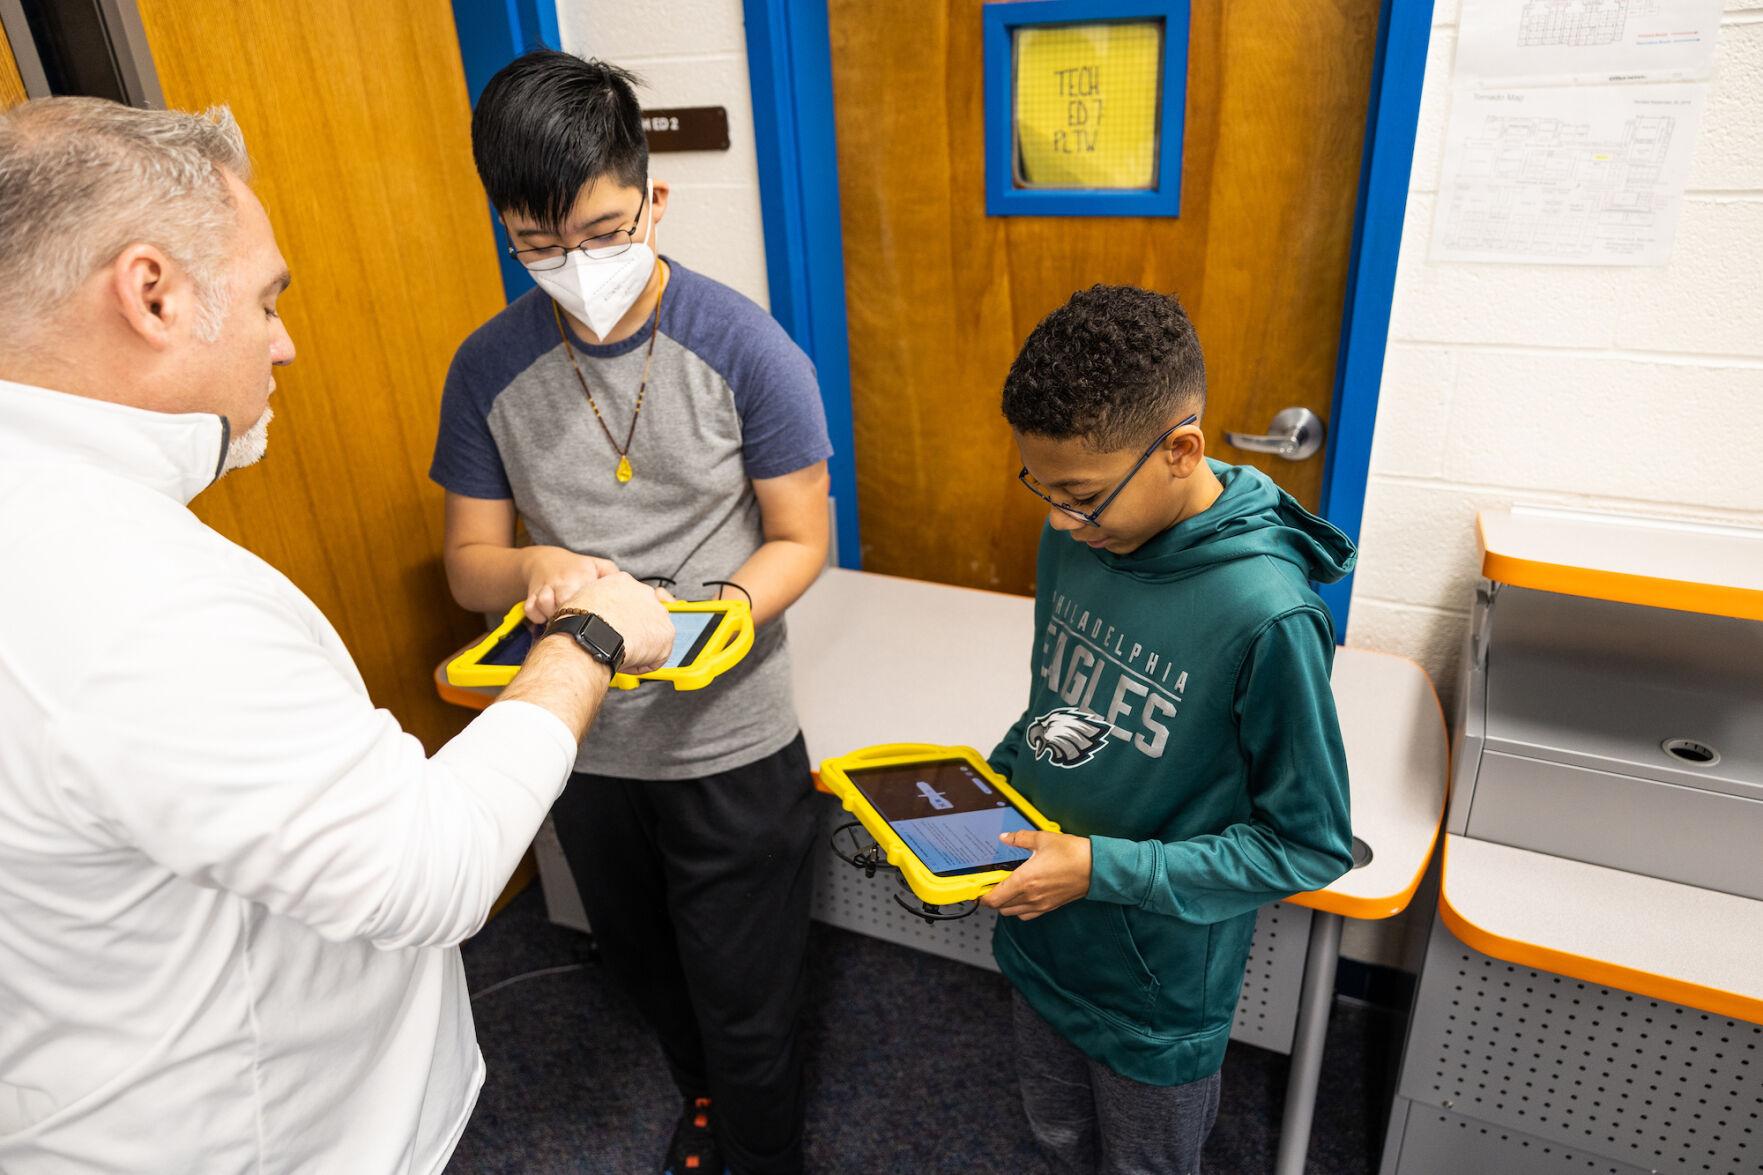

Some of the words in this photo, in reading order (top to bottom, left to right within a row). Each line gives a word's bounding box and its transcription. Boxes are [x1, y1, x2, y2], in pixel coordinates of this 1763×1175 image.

[1054, 65, 1100, 97] TECH
[1068, 100, 1088, 127] ED
[1054, 128, 1099, 153] PLTW
[1041, 621, 1177, 759] EAGLES
